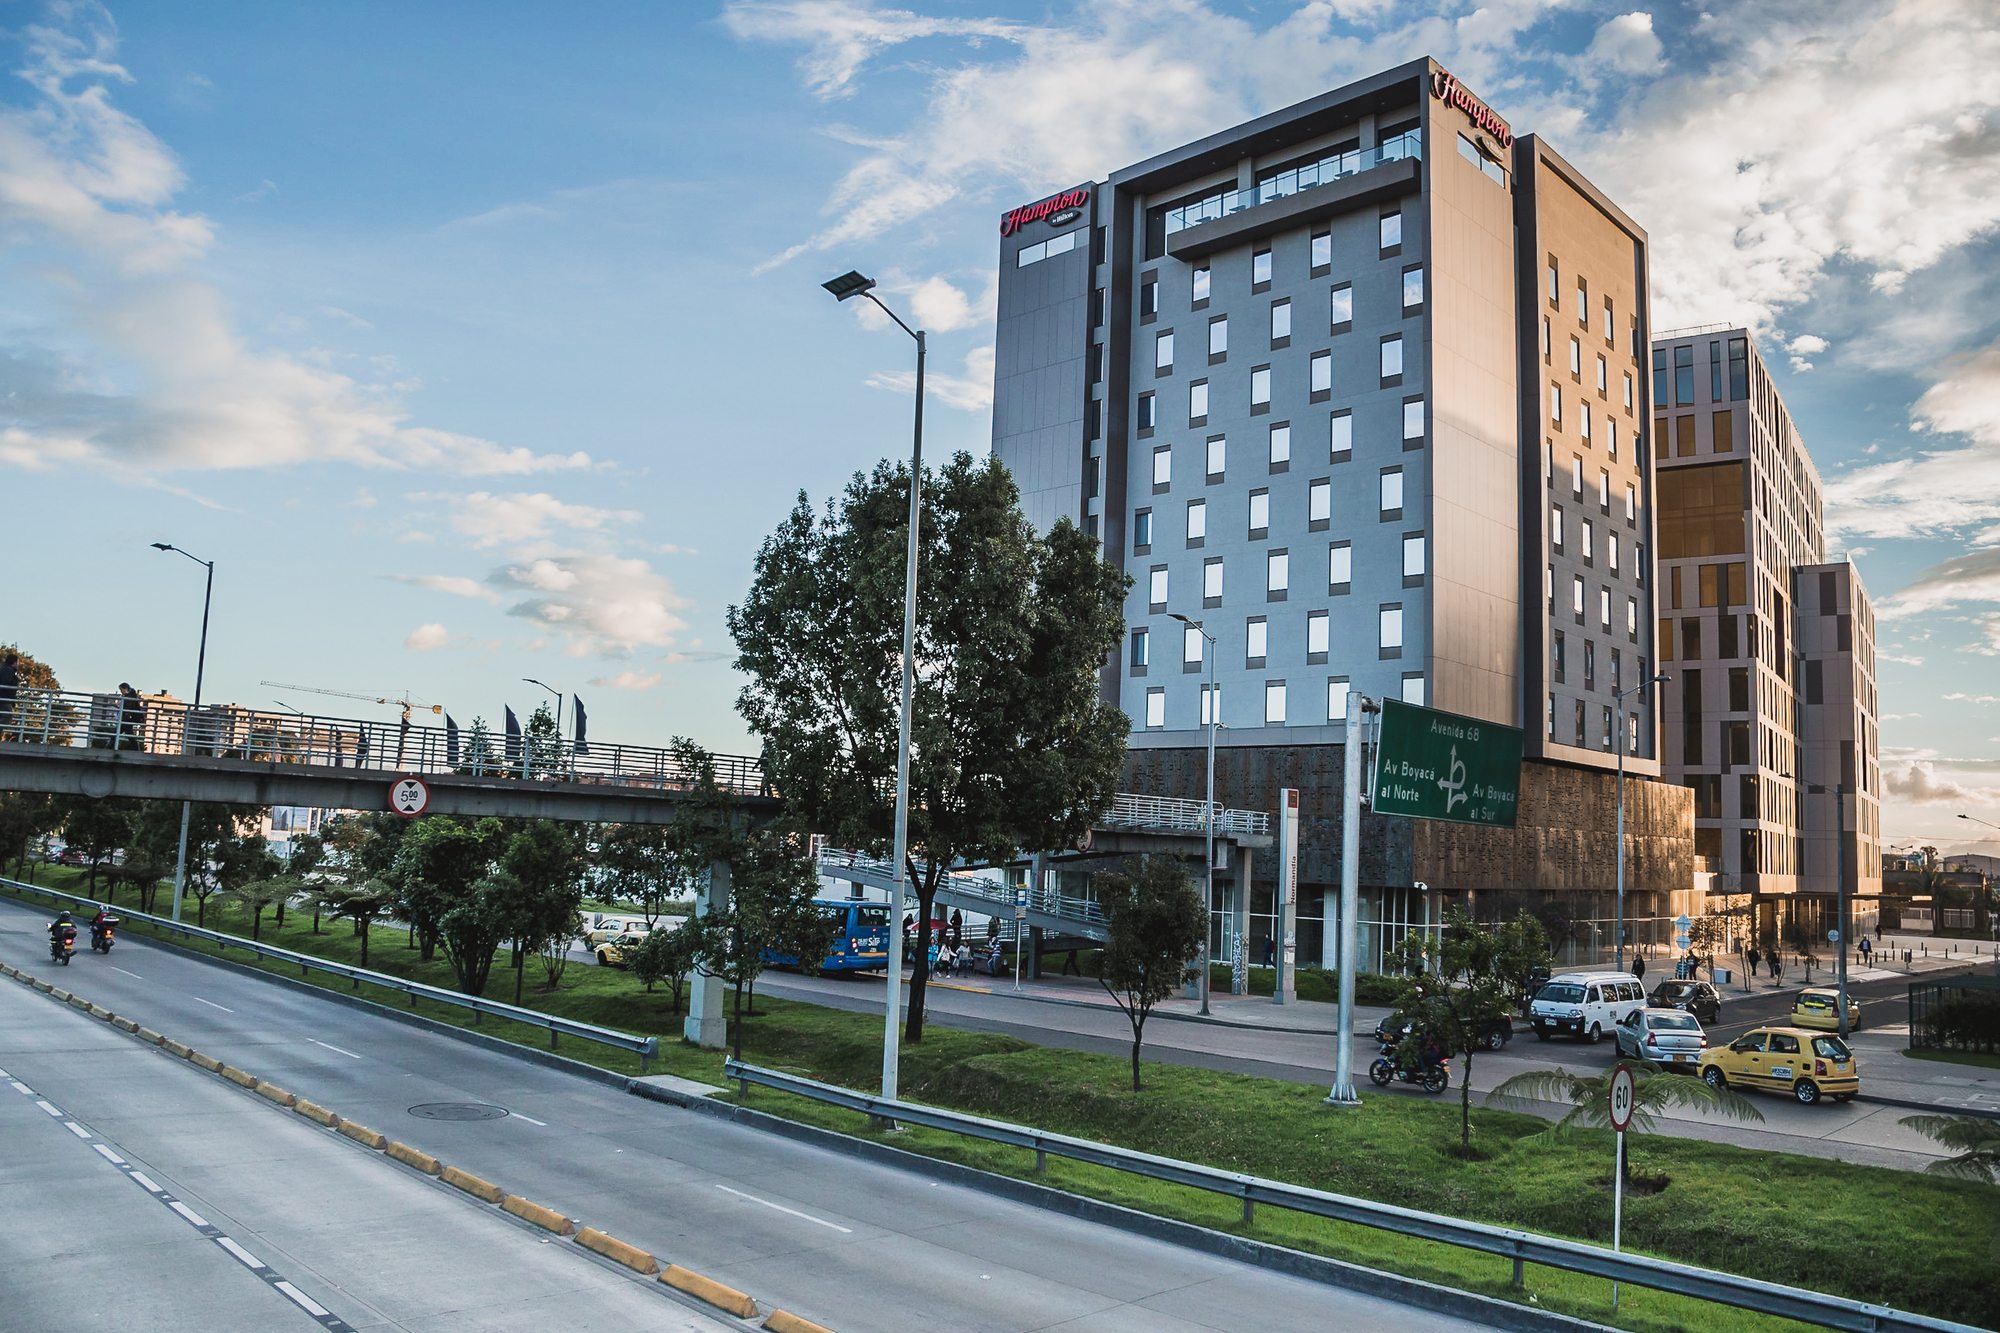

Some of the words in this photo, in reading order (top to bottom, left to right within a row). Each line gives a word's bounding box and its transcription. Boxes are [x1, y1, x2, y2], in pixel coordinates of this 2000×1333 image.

[1434, 71, 1513, 148] Hampton
[1000, 191, 1086, 236] Hampton
[1430, 718, 1464, 739] Avenida
[1467, 726, 1480, 742] 68
[1383, 758, 1398, 775] Av
[1401, 761, 1435, 781] Boyacá
[1381, 784, 1391, 798] al
[1393, 784, 1419, 801] Norte
[1472, 783, 1485, 798] Av
[1487, 785, 1515, 804] Boyacá
[1470, 807, 1479, 819] al
[1481, 806, 1496, 820] Sur
[1616, 1085, 1628, 1110] 60
